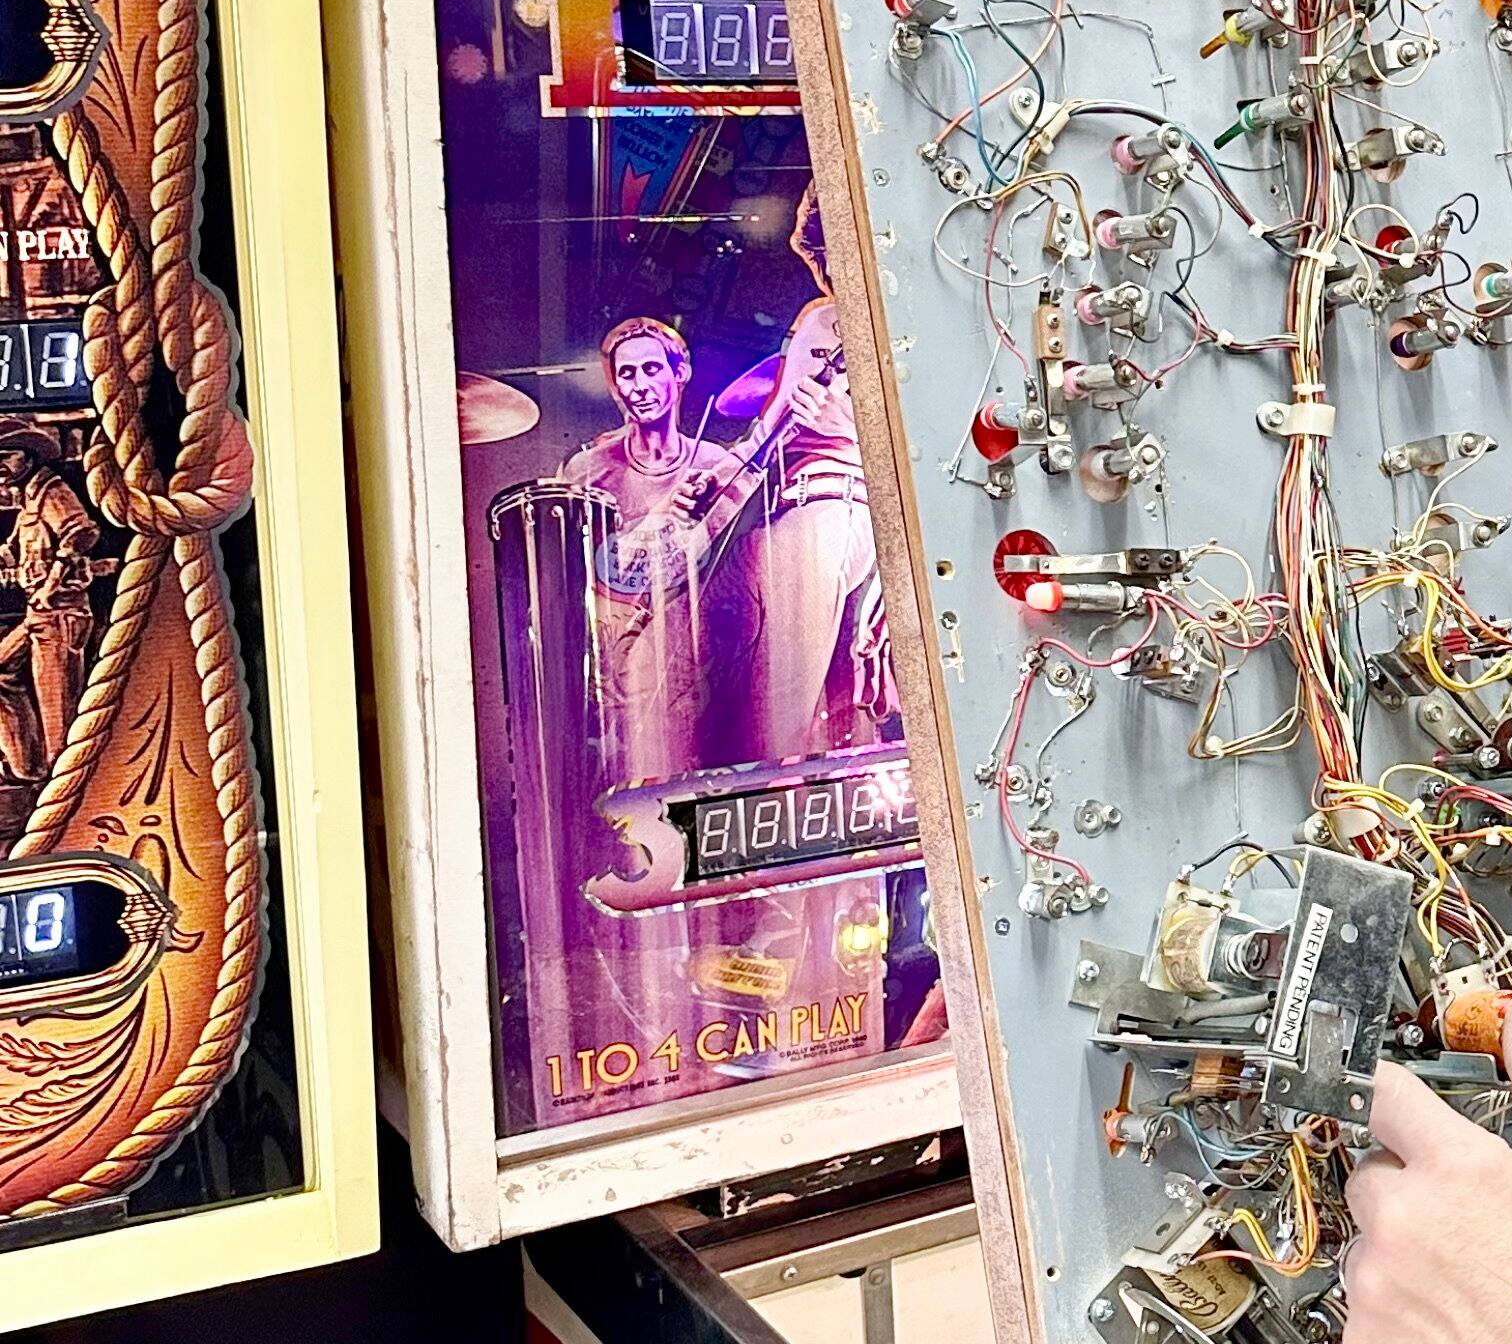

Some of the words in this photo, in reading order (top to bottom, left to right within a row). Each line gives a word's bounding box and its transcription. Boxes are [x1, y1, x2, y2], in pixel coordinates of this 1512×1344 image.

[16, 227, 92, 262] PLAY
[1301, 912, 1327, 974] PATENT
[546, 1055, 564, 1097] 1
[576, 1042, 639, 1091] TO
[649, 1029, 681, 1072] 4
[695, 1011, 778, 1064] CAN
[790, 992, 868, 1046] PLAY
[1279, 975, 1310, 1050] PENDING
